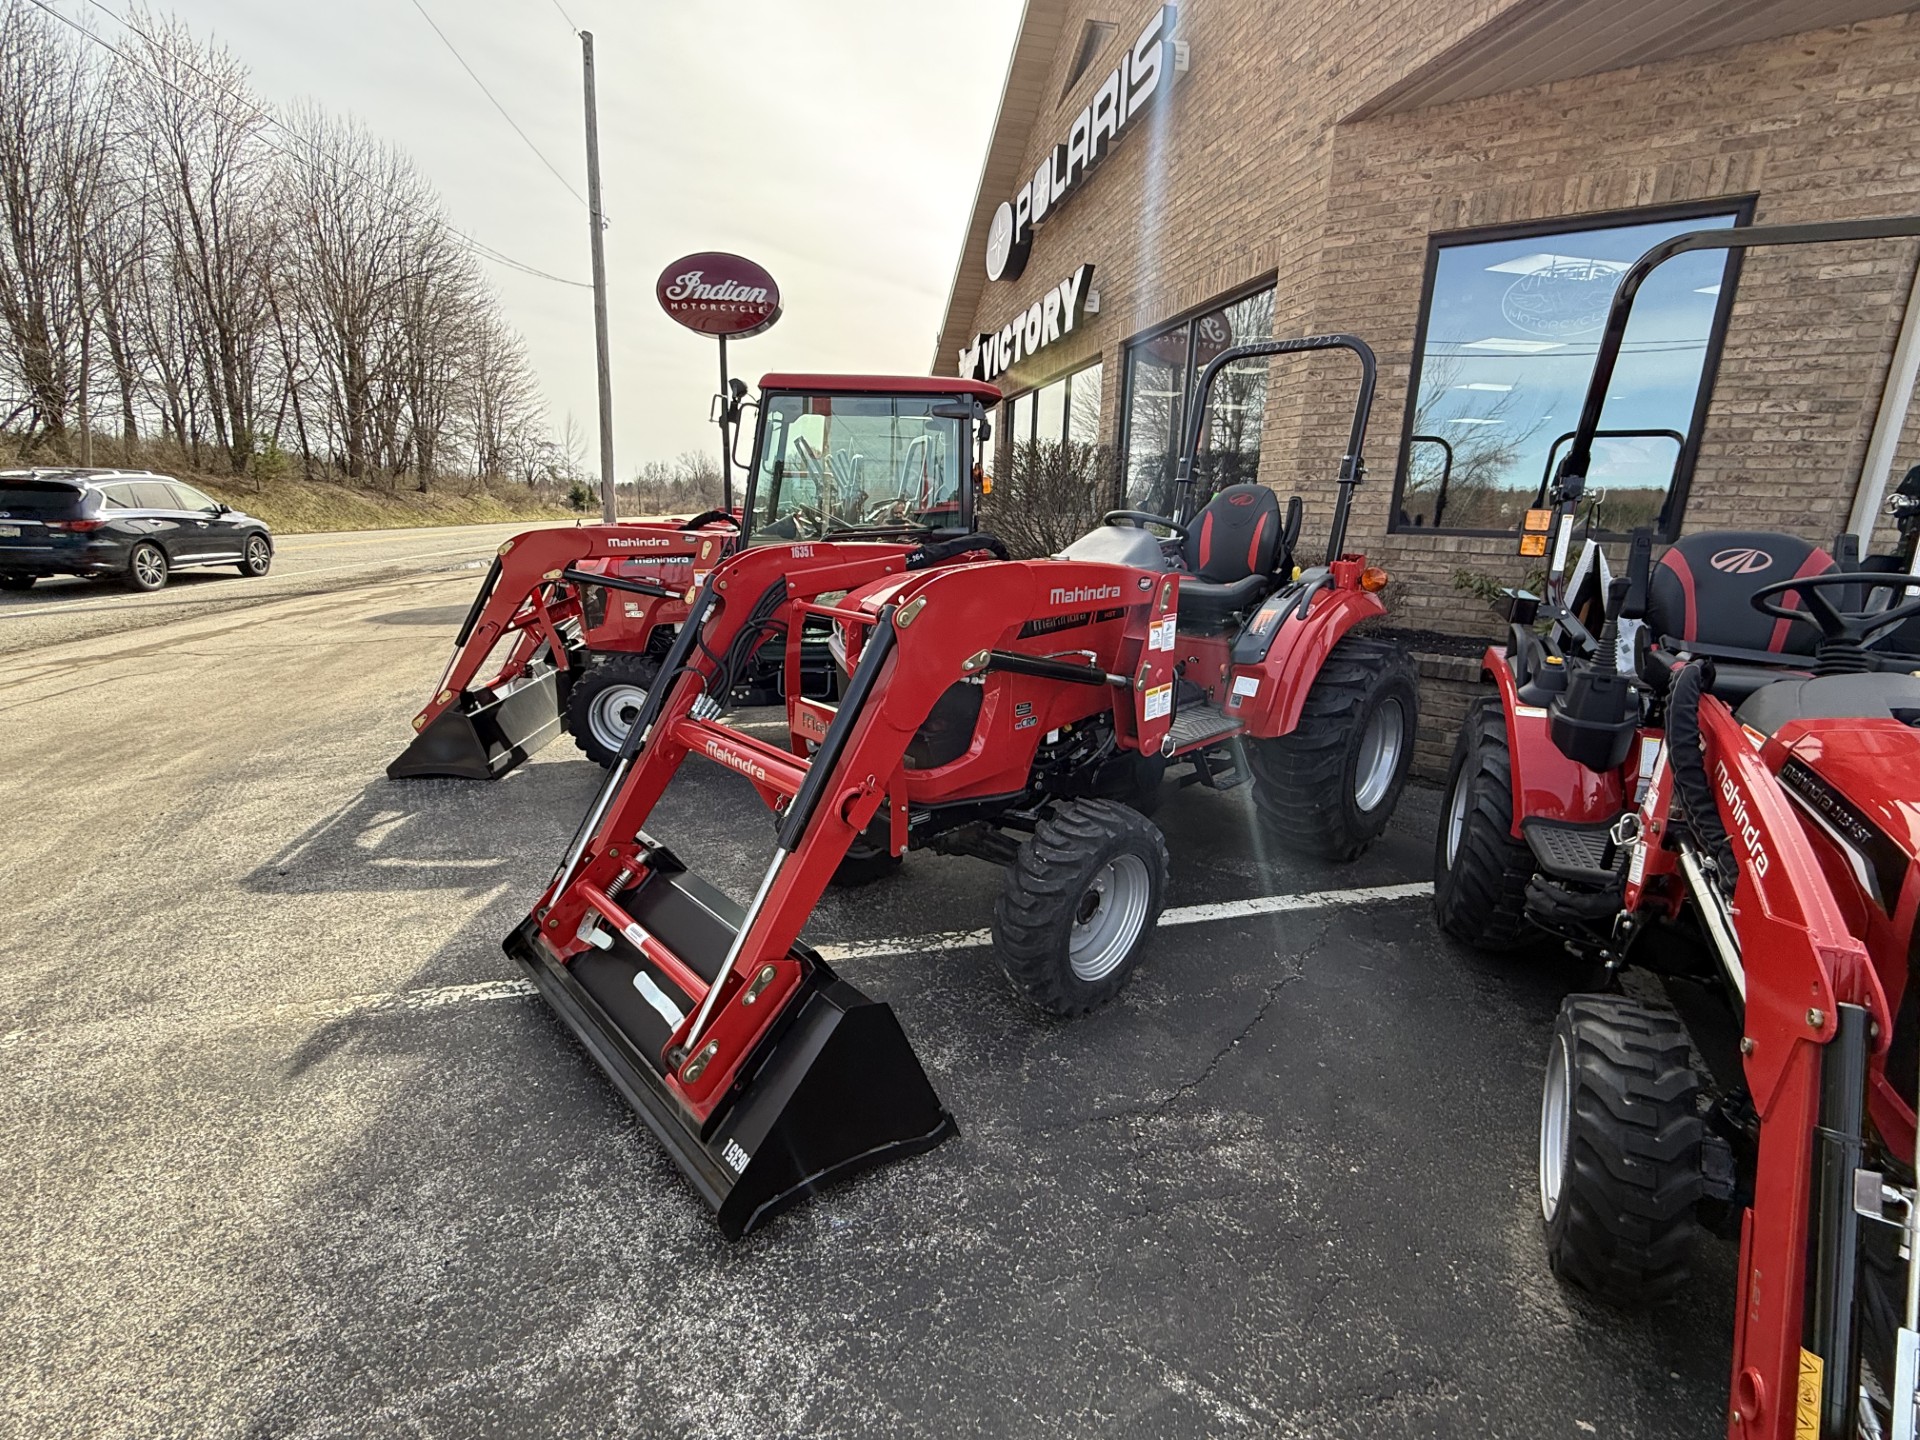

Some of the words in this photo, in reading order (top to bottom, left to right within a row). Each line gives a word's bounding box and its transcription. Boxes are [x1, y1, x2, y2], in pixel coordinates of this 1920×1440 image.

[1015, 5, 1167, 244] POLARIS
[665, 270, 768, 303] Indian
[670, 302, 765, 314] MOTORCYCLE
[982, 264, 1087, 381] VICTORY
[1049, 584, 1121, 605] Mahindra
[721, 1137, 751, 1175] 1635L
